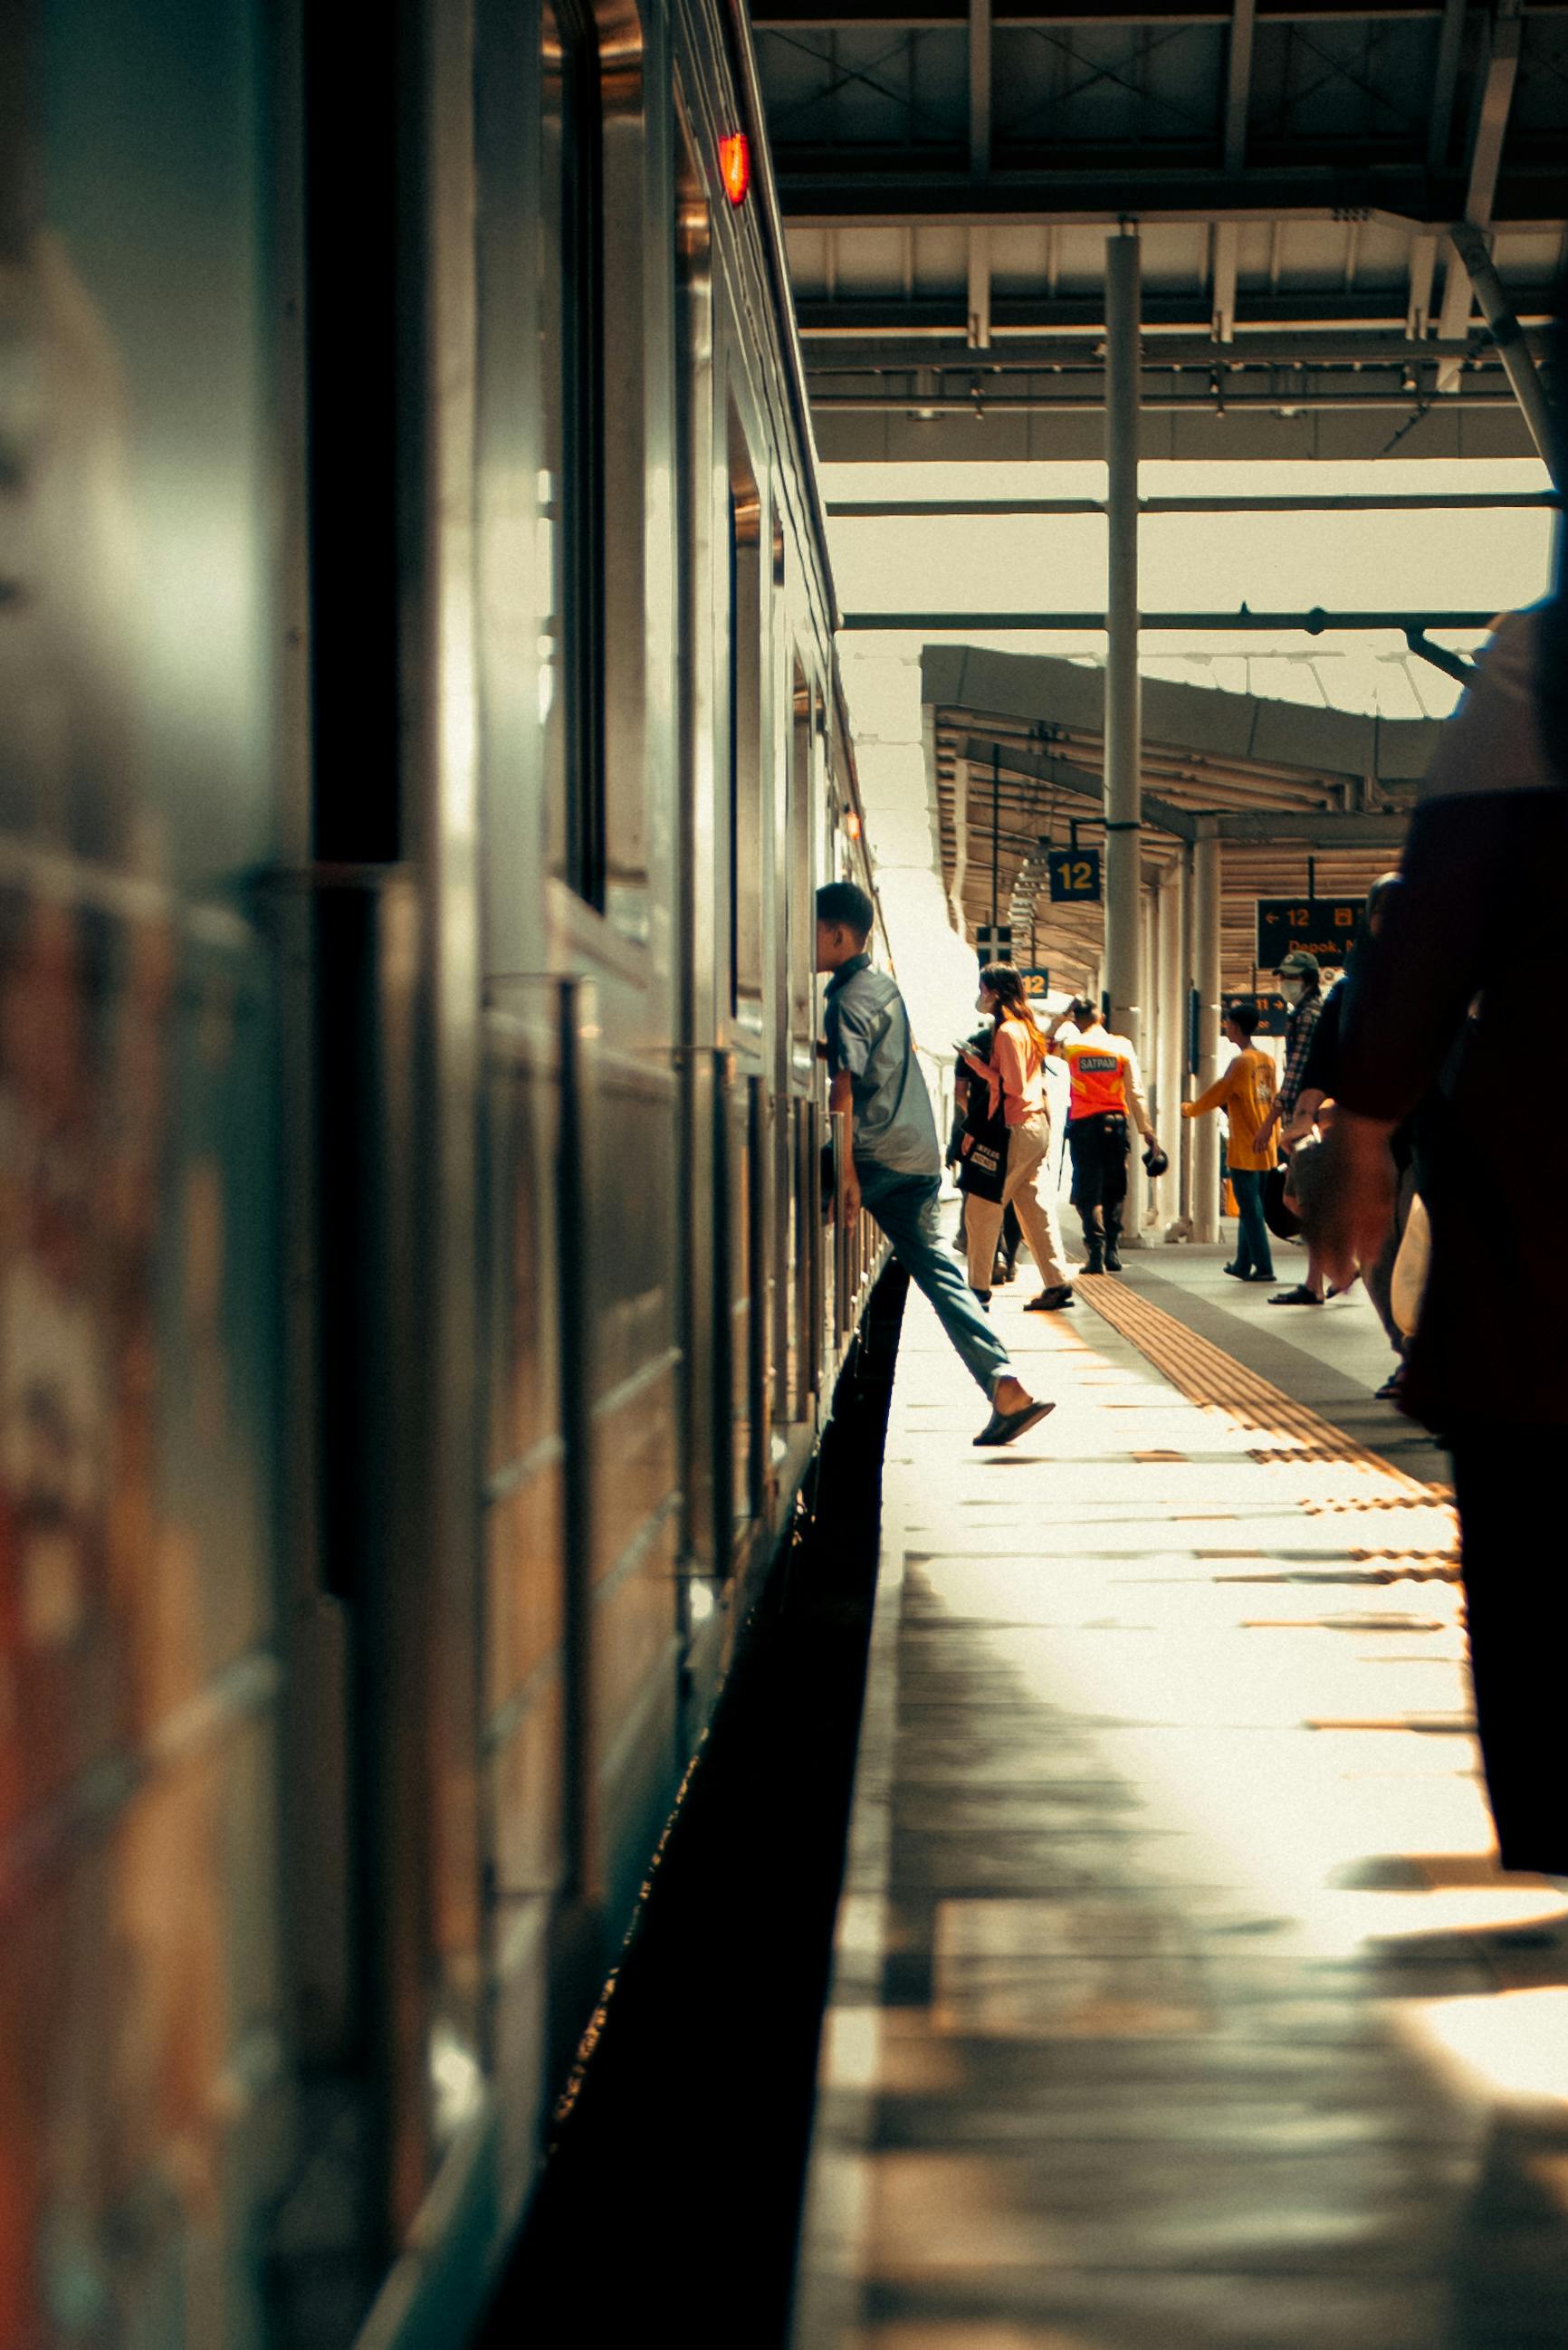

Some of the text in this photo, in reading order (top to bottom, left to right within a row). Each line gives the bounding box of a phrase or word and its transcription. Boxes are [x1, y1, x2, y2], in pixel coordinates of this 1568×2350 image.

[1057, 862, 1093, 890] 12
[1286, 907, 1310, 927] 12
[1023, 976, 1045, 994] 12
[1079, 1057, 1116, 1070] SATPAM
